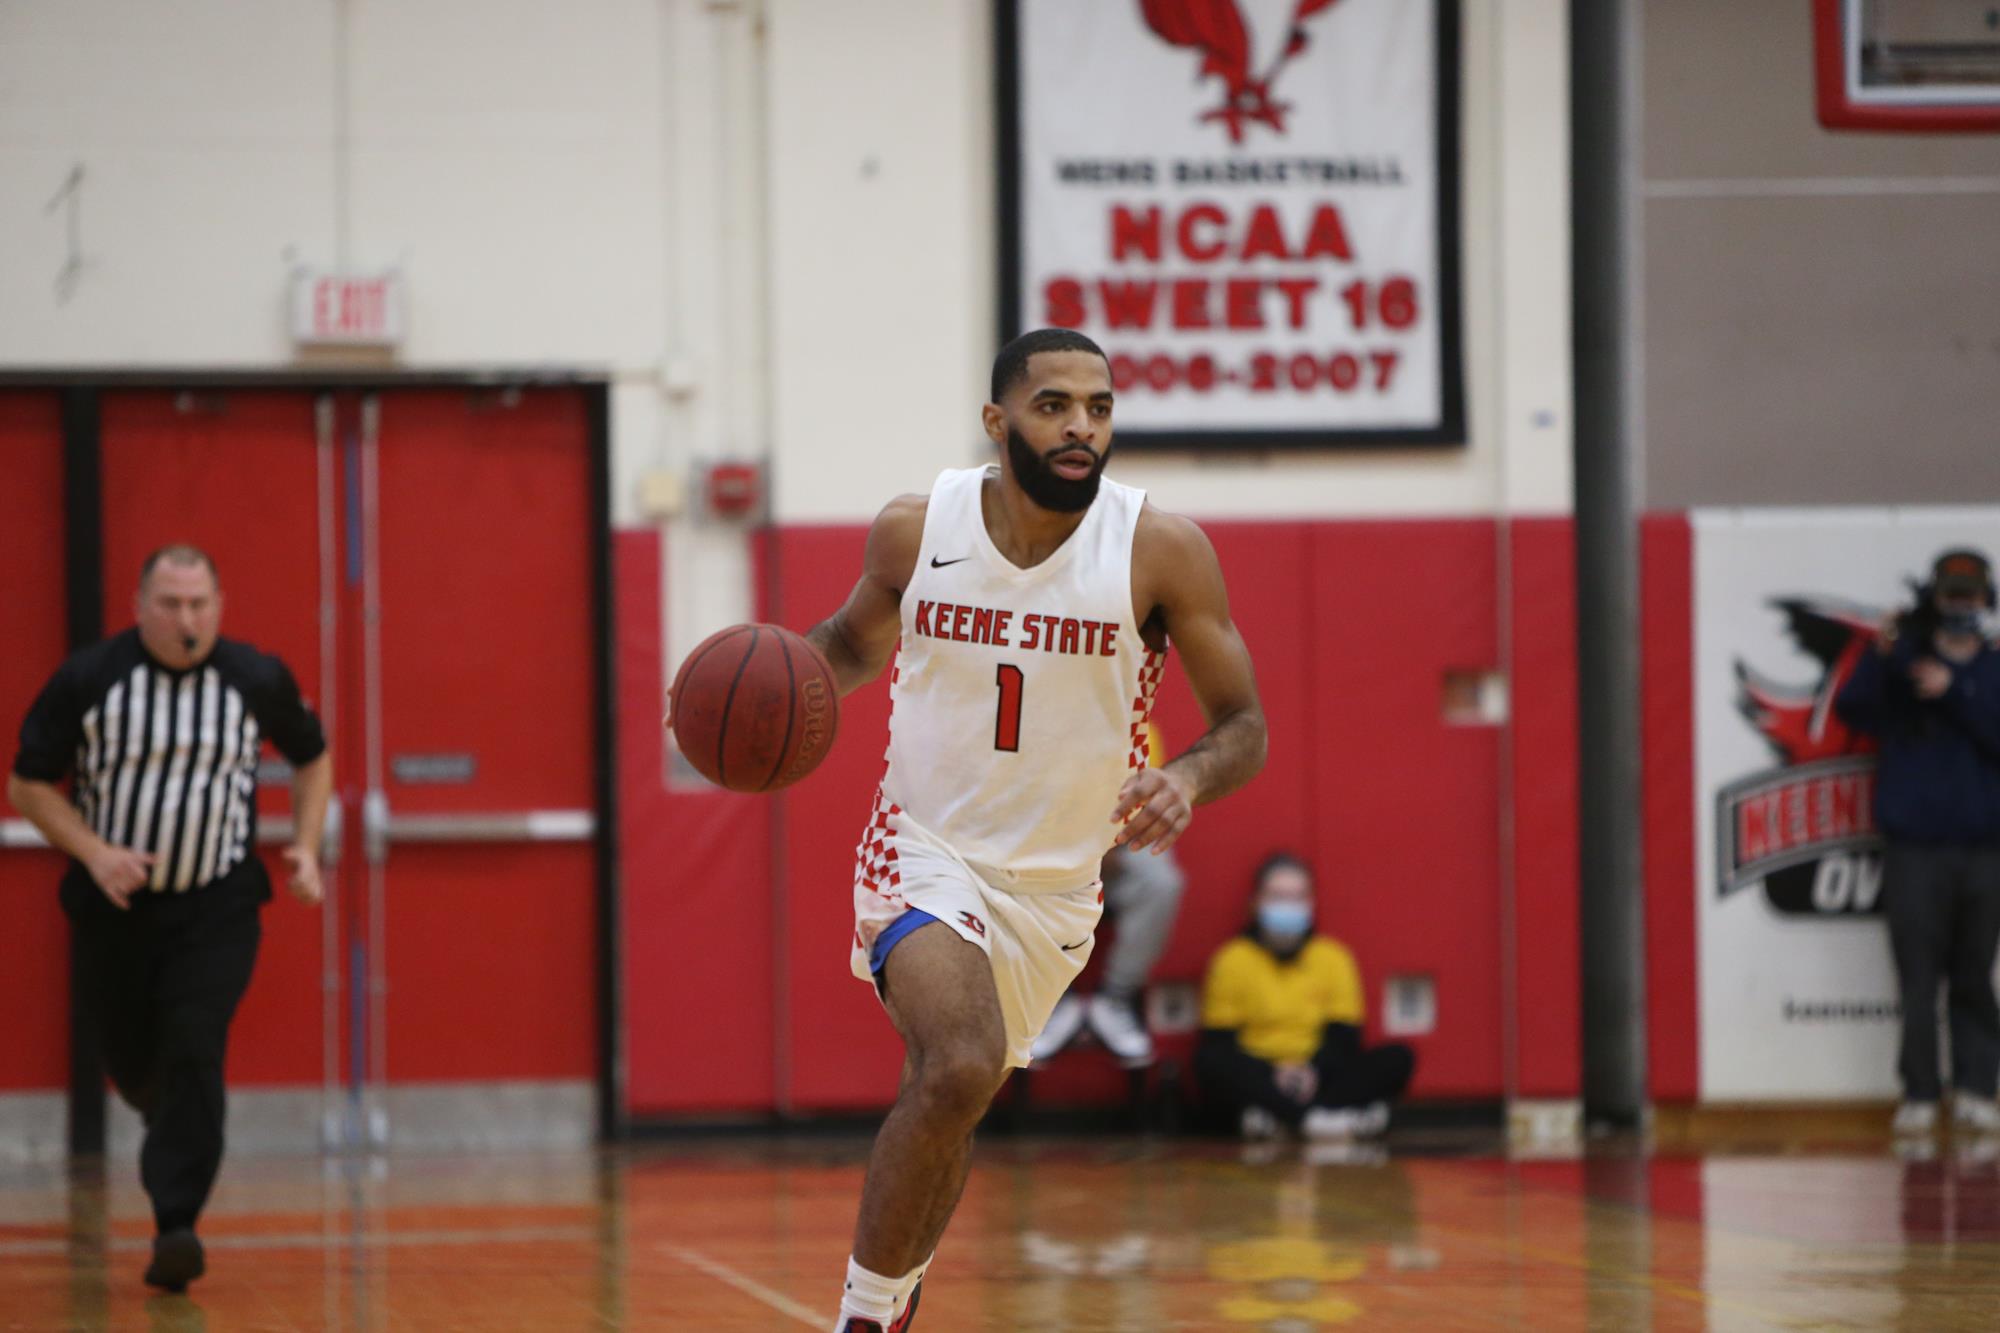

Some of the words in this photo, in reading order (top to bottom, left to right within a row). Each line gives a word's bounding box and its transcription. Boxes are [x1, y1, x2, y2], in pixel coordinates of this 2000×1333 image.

[1174, 158, 1404, 185] BASKETBALL
[1109, 203, 1353, 262] NCAA
[314, 276, 387, 335] EXIT
[1044, 276, 1317, 330] SWEET
[1341, 276, 1418, 330] 16
[1111, 352, 1399, 392] 006-2007
[915, 600, 1013, 647] KEENE
[1019, 614, 1120, 657] STATE
[994, 663, 1024, 753] 1
[1739, 773, 1871, 860] KEEN
